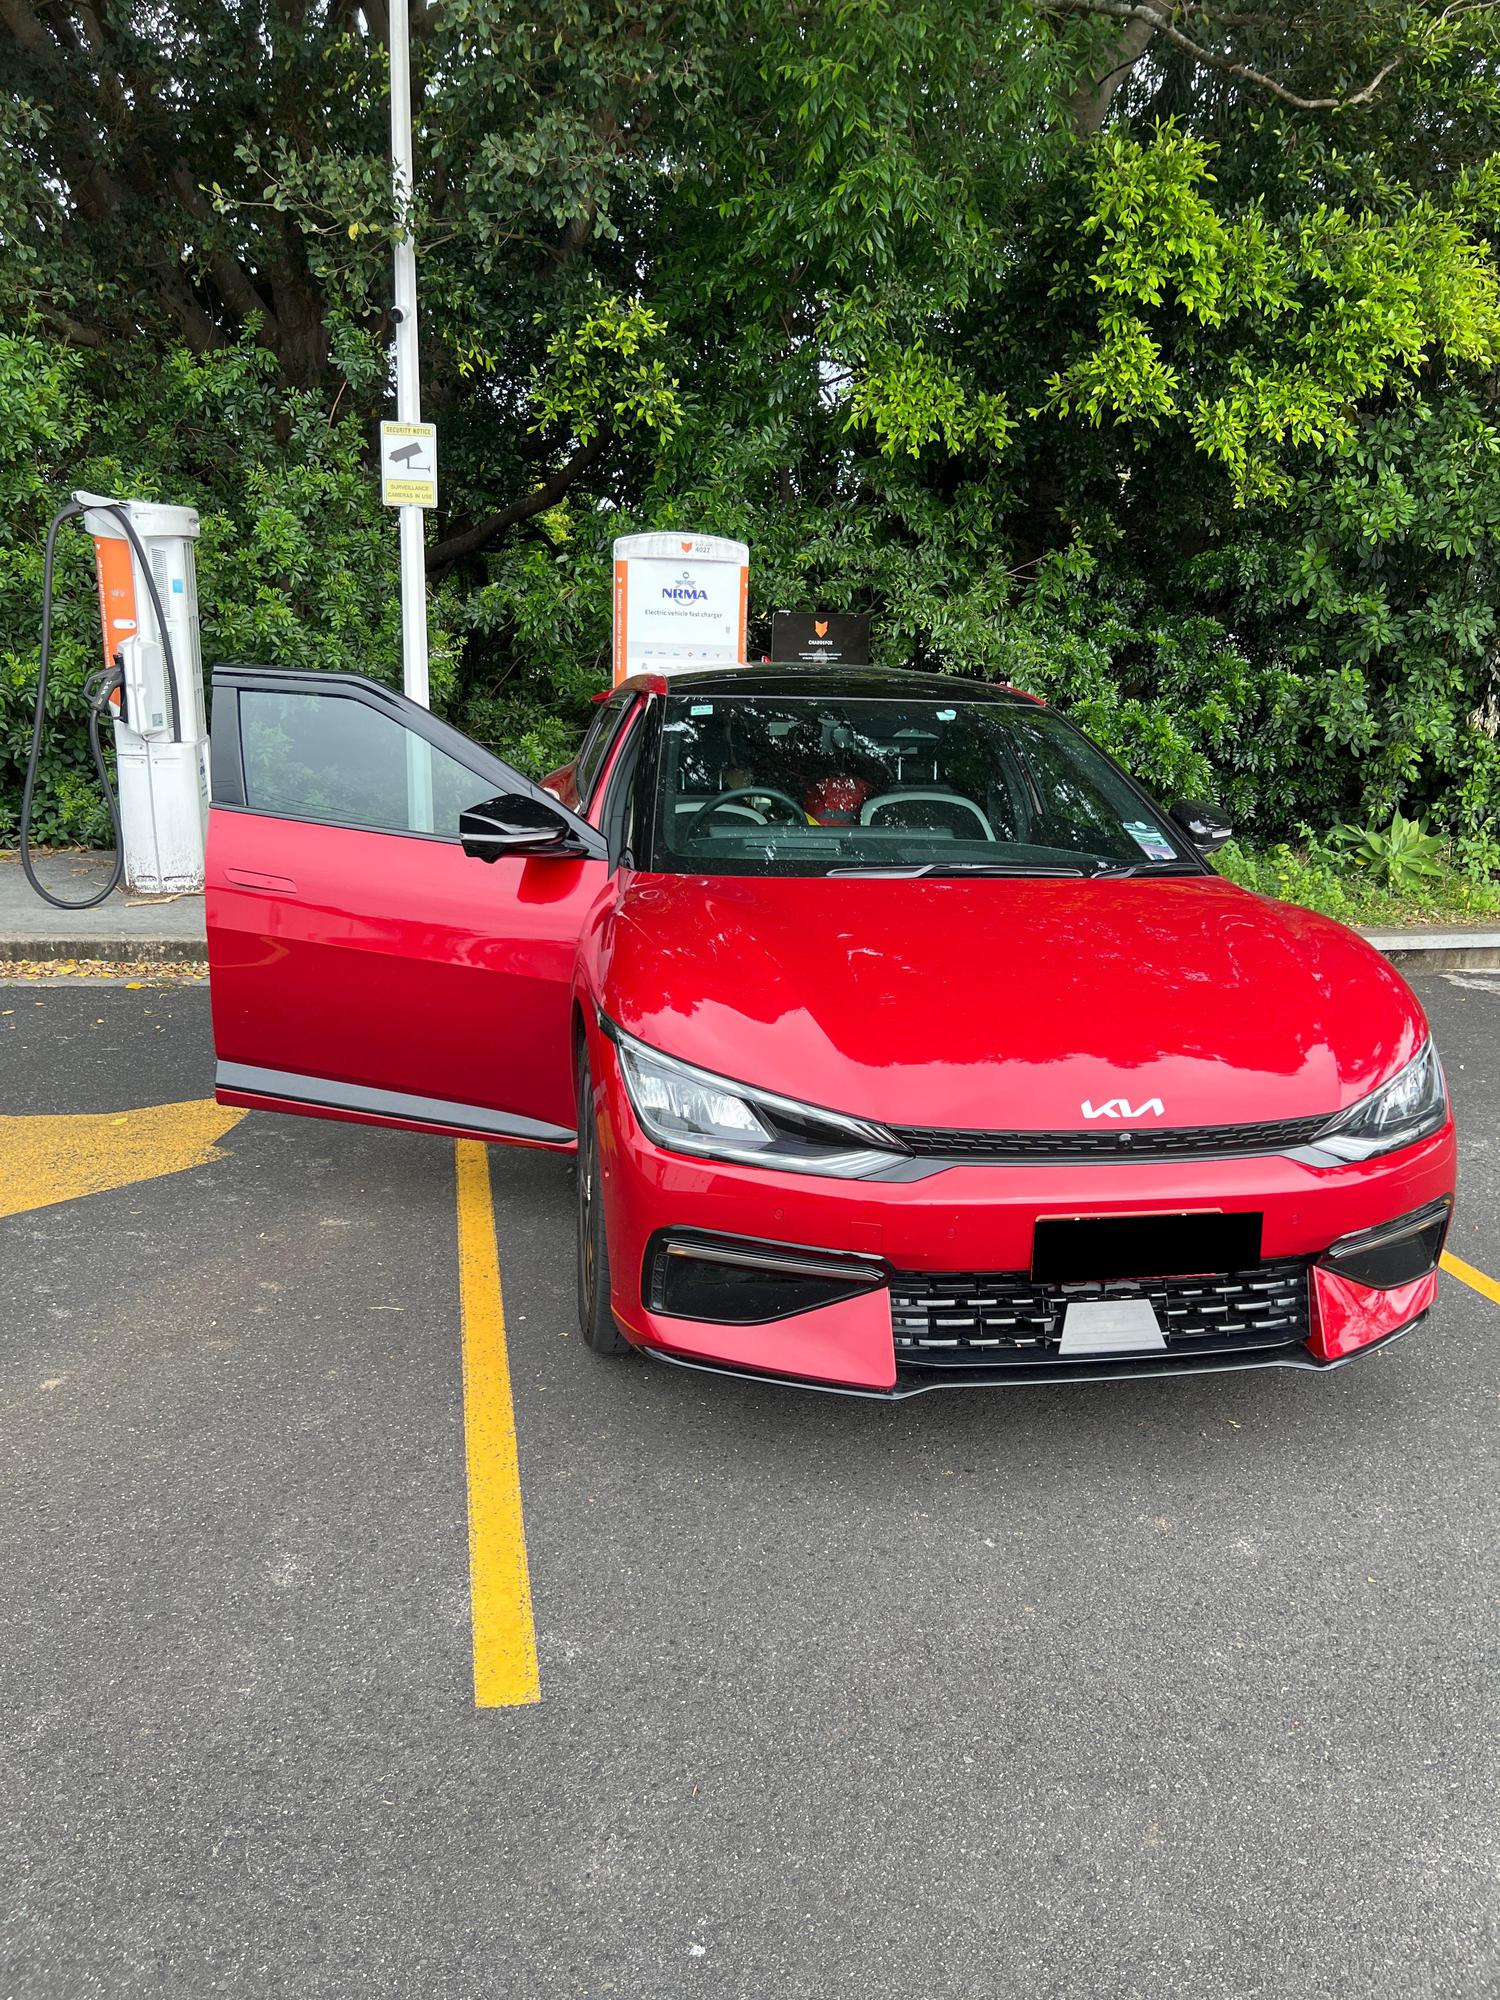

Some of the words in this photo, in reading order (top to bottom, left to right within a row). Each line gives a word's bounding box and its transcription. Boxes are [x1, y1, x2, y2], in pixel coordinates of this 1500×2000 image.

[386, 426, 411, 434] SECURITY
[662, 588, 708, 600] NRMA
[1081, 1098, 1165, 1119] KIA
